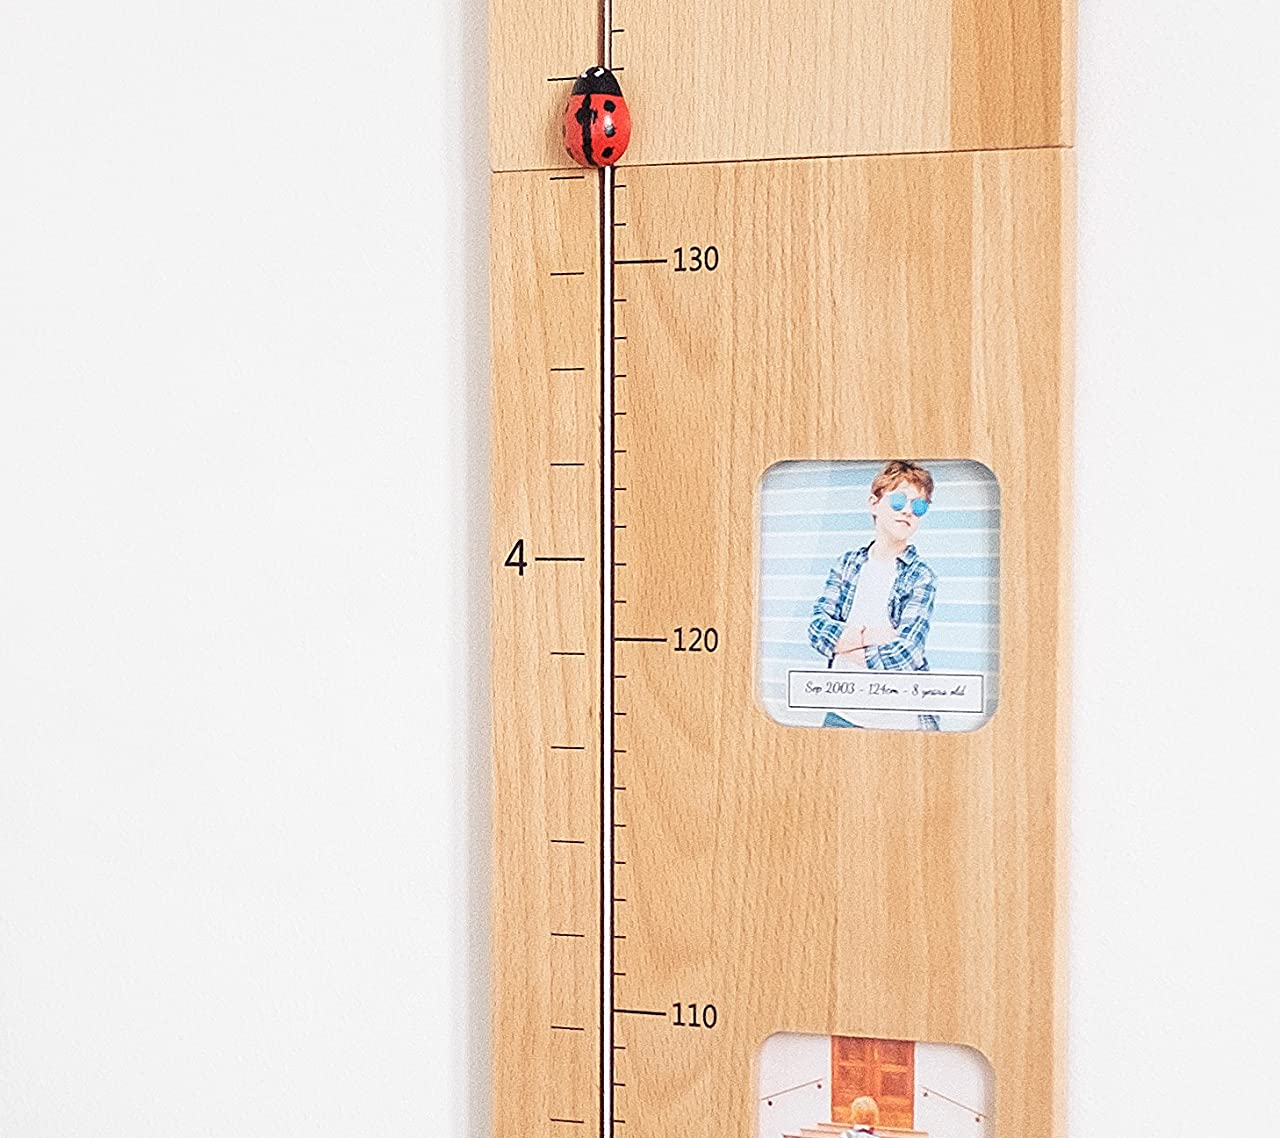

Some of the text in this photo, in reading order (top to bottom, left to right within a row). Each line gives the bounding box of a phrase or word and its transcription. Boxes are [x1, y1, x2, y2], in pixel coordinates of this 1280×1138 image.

[673, 246, 719, 272] 130
[504, 538, 528, 577] 4
[673, 626, 719, 653] 120
[805, 681, 822, 695] Sep
[825, 681, 856, 695] 2003
[869, 683, 899, 696] 124cm
[911, 684, 919, 696] 8
[949, 685, 966, 697] old
[671, 1002, 718, 1030] 110
